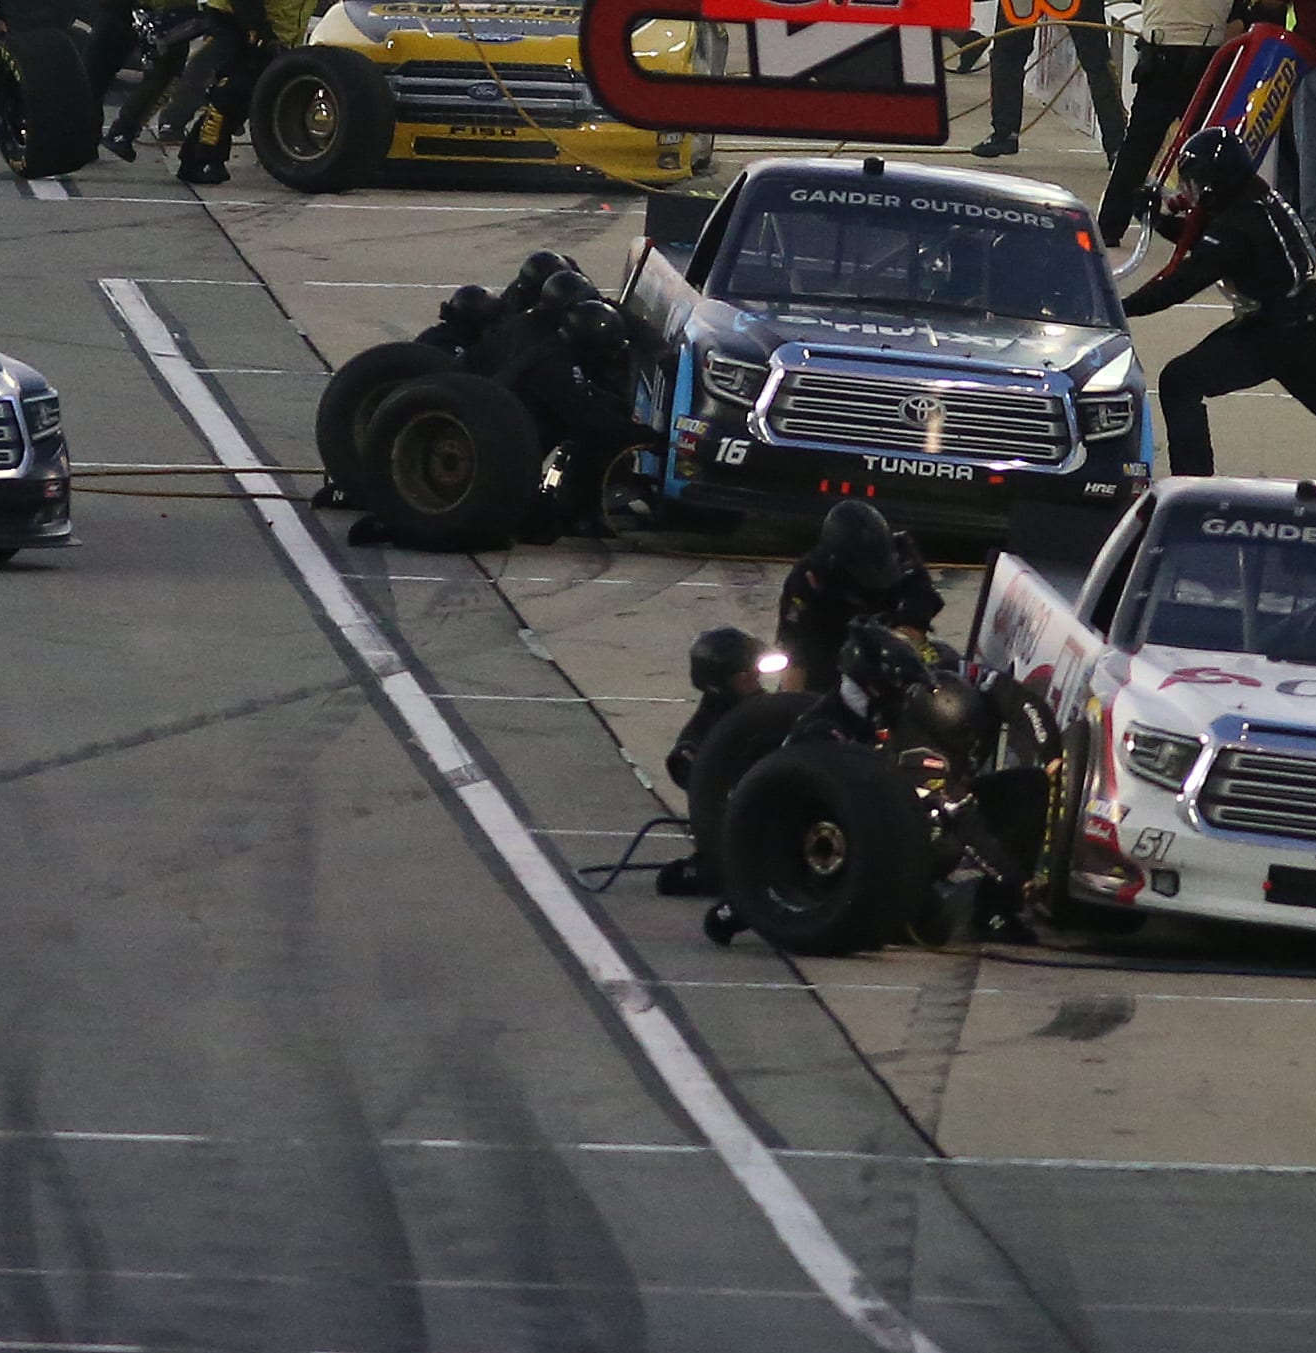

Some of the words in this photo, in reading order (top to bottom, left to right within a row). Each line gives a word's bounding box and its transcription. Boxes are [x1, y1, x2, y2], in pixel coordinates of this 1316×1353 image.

[1246, 60, 1296, 158] SUNOCO
[790, 189, 901, 208] GANDER
[911, 198, 1056, 229] OUTDOORS
[715, 437, 751, 465] 16
[863, 454, 974, 481] TUNDRA
[1084, 481, 1117, 495] HRE
[1132, 826, 1176, 862] 51
